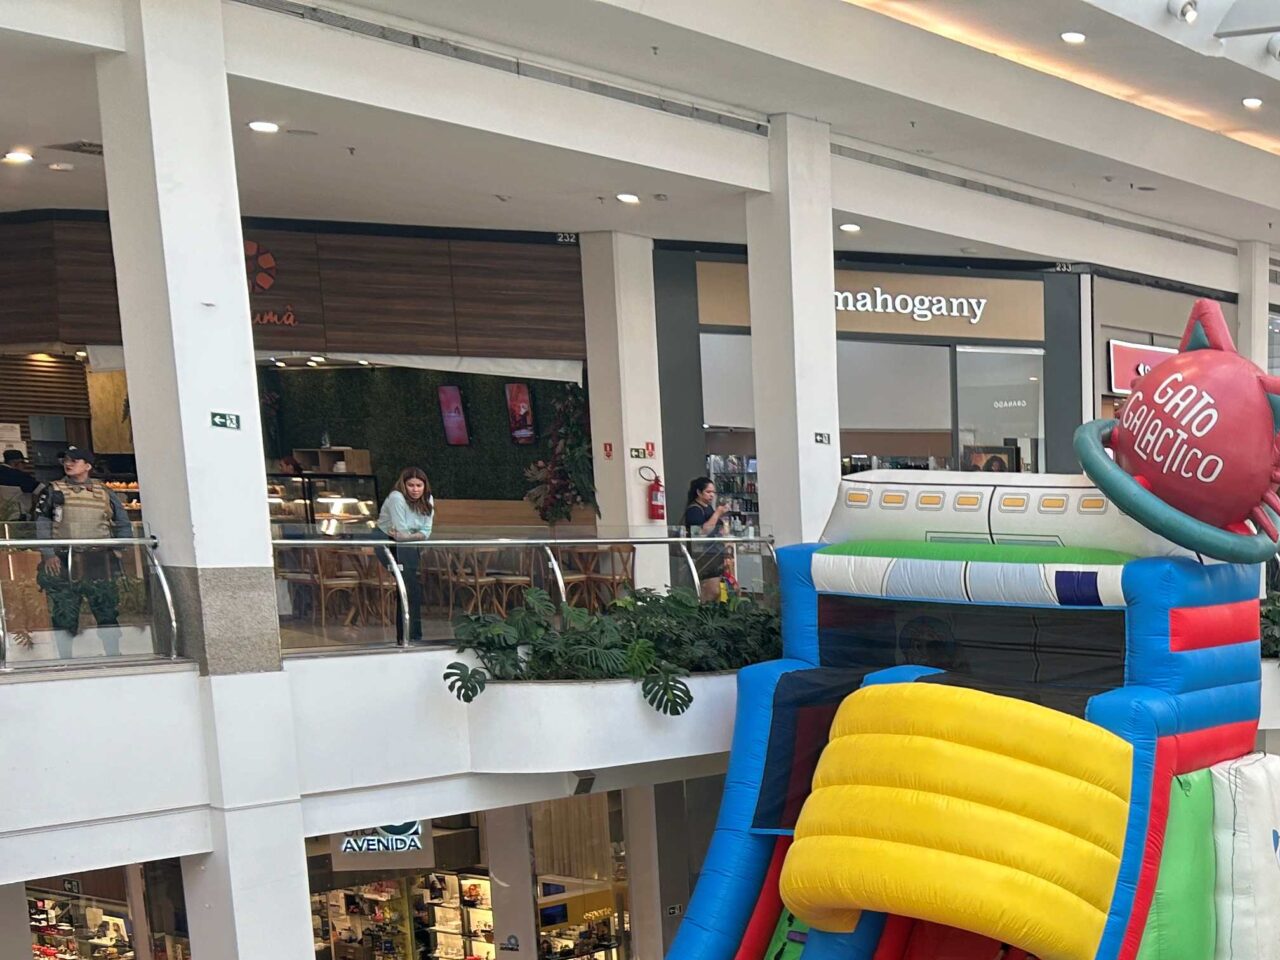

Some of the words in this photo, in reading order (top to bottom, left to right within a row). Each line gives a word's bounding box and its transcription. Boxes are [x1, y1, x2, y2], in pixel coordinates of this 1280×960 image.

[558, 233, 577, 243] 232
[1056, 262, 1072, 272] 233
[834, 287, 987, 324] mahogany
[1153, 372, 1219, 438] GATO
[1122, 391, 1224, 483] GALACTICO
[343, 837, 421, 852] AVENIDA
